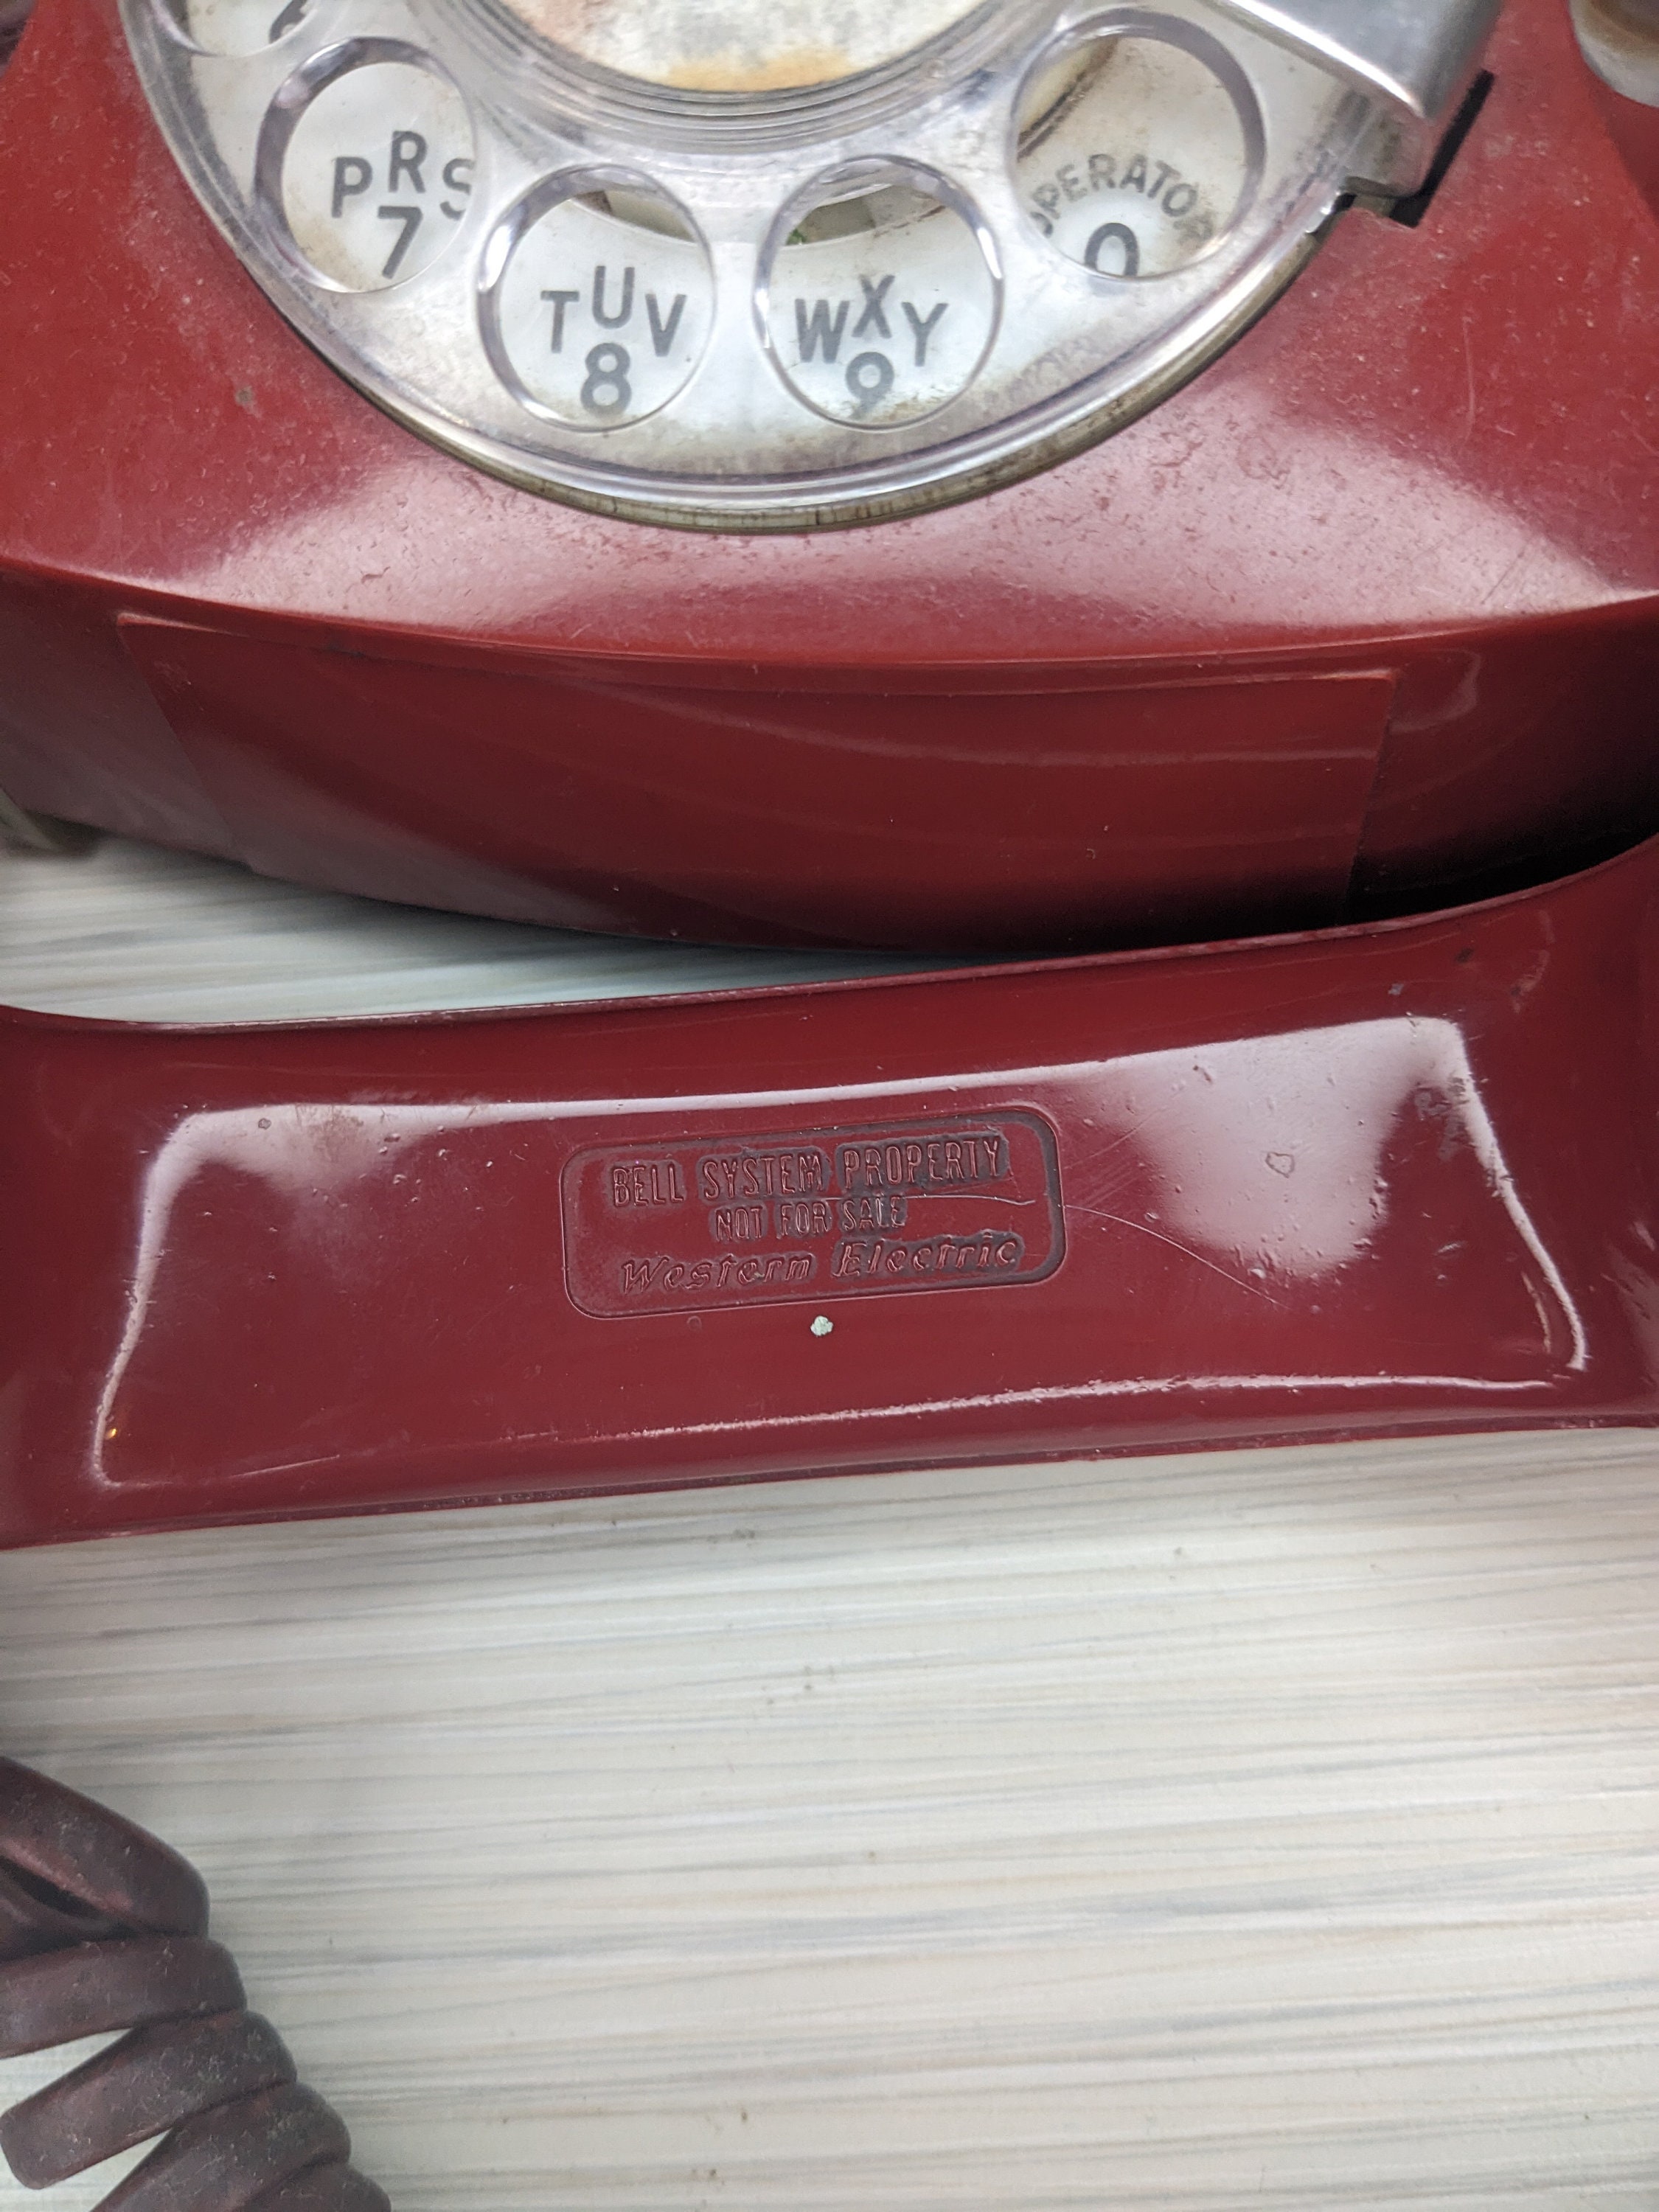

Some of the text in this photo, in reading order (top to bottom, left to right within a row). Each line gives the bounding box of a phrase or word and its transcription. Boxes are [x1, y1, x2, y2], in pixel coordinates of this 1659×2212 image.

[331, 130, 476, 220] PRS
[377, 205, 423, 279] 7
[540, 265, 687, 357] TUV
[794, 274, 949, 368] WXY
[580, 343, 631, 416] 8
[845, 352, 894, 420] 9
[613, 1135, 1001, 1208] BELL SYSTEM PROPERTY
[716, 1195, 907, 1242] NOT FOR SALE
[622, 1231, 1017, 1295] Western Electric
